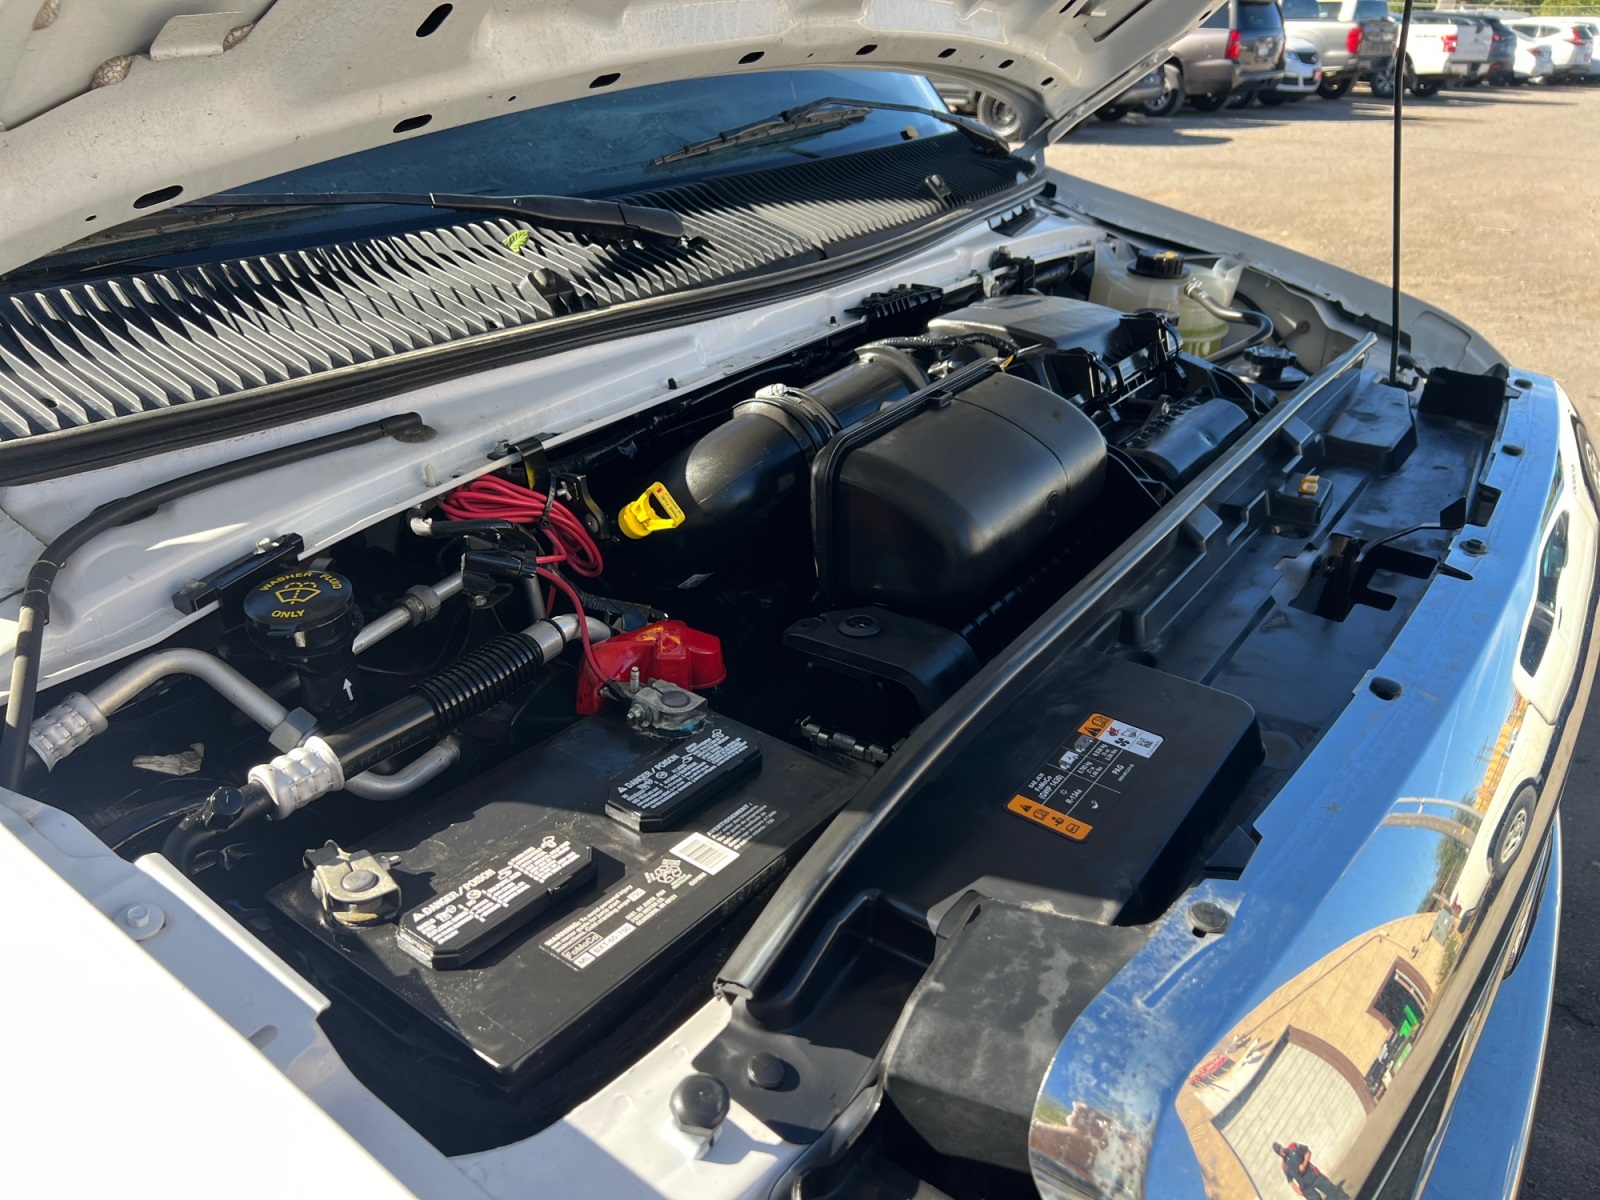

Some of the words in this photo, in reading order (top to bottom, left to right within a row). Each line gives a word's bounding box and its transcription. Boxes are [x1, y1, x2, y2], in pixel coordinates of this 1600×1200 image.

[260, 572, 312, 591] WASHER
[319, 573, 342, 590] FLUID
[271, 609, 305, 618] ONLY
[624, 770, 653, 789] DANGER
[654, 754, 680, 771] POISON
[1112, 764, 1124, 774] PAG
[1034, 775, 1052, 792] FoMoCo
[1065, 788, 1083, 805] R-134a
[707, 804, 749, 836] AVERTISSEMENT
[544, 920, 582, 946] WARNING:
[565, 934, 600, 958] FoMoCo
[578, 955, 591, 964] ML
[592, 925, 632, 953] BXT-65-750
